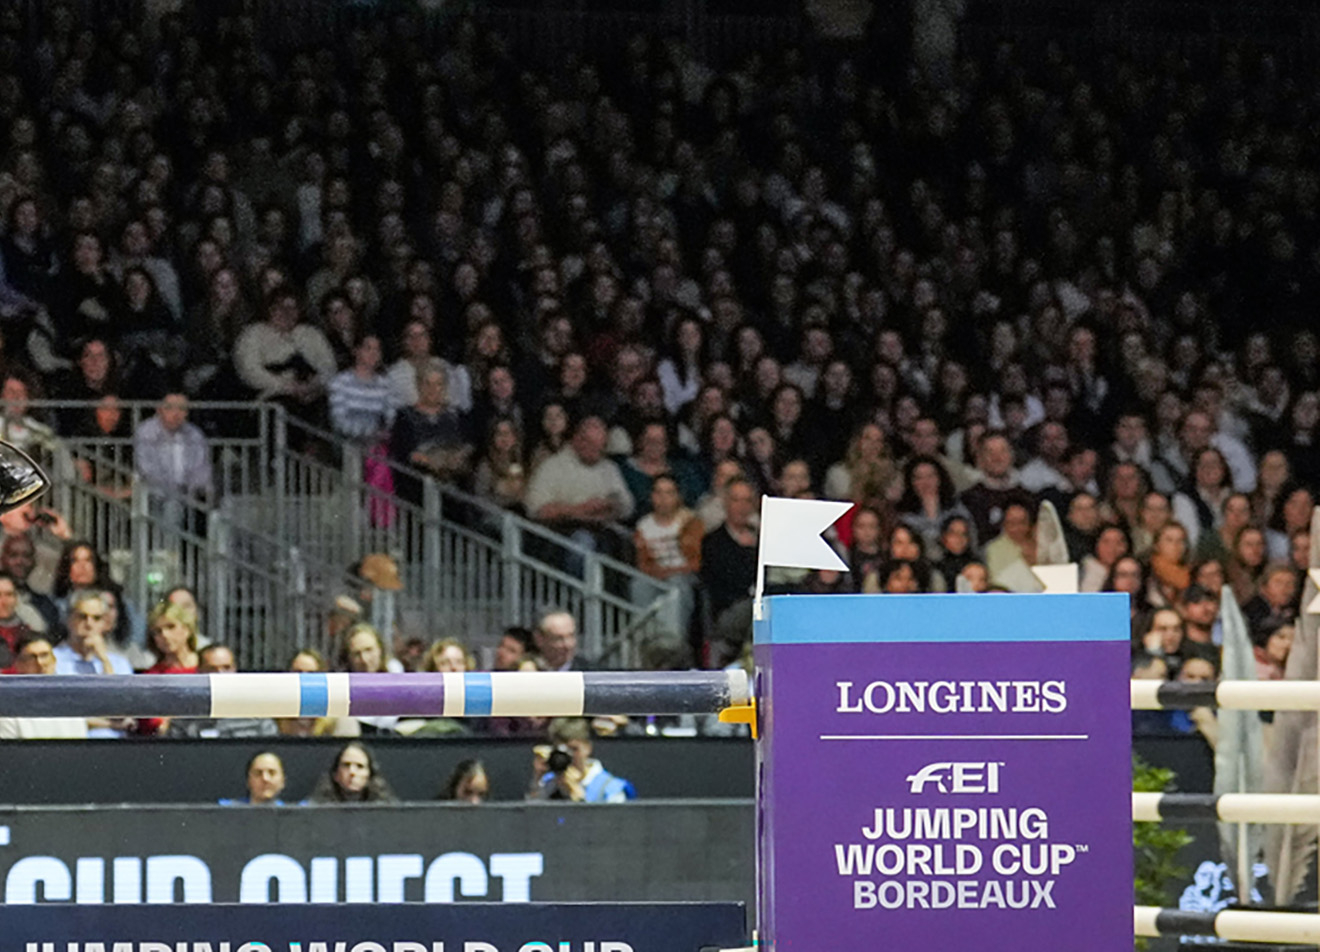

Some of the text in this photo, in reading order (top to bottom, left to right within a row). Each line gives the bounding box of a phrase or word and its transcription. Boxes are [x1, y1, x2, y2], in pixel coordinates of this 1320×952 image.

[836, 680, 1067, 714] LONGINES
[862, 807, 1048, 840] JUMPING
[834, 844, 983, 875] WORLD
[854, 880, 1056, 909] BORDEAUX
